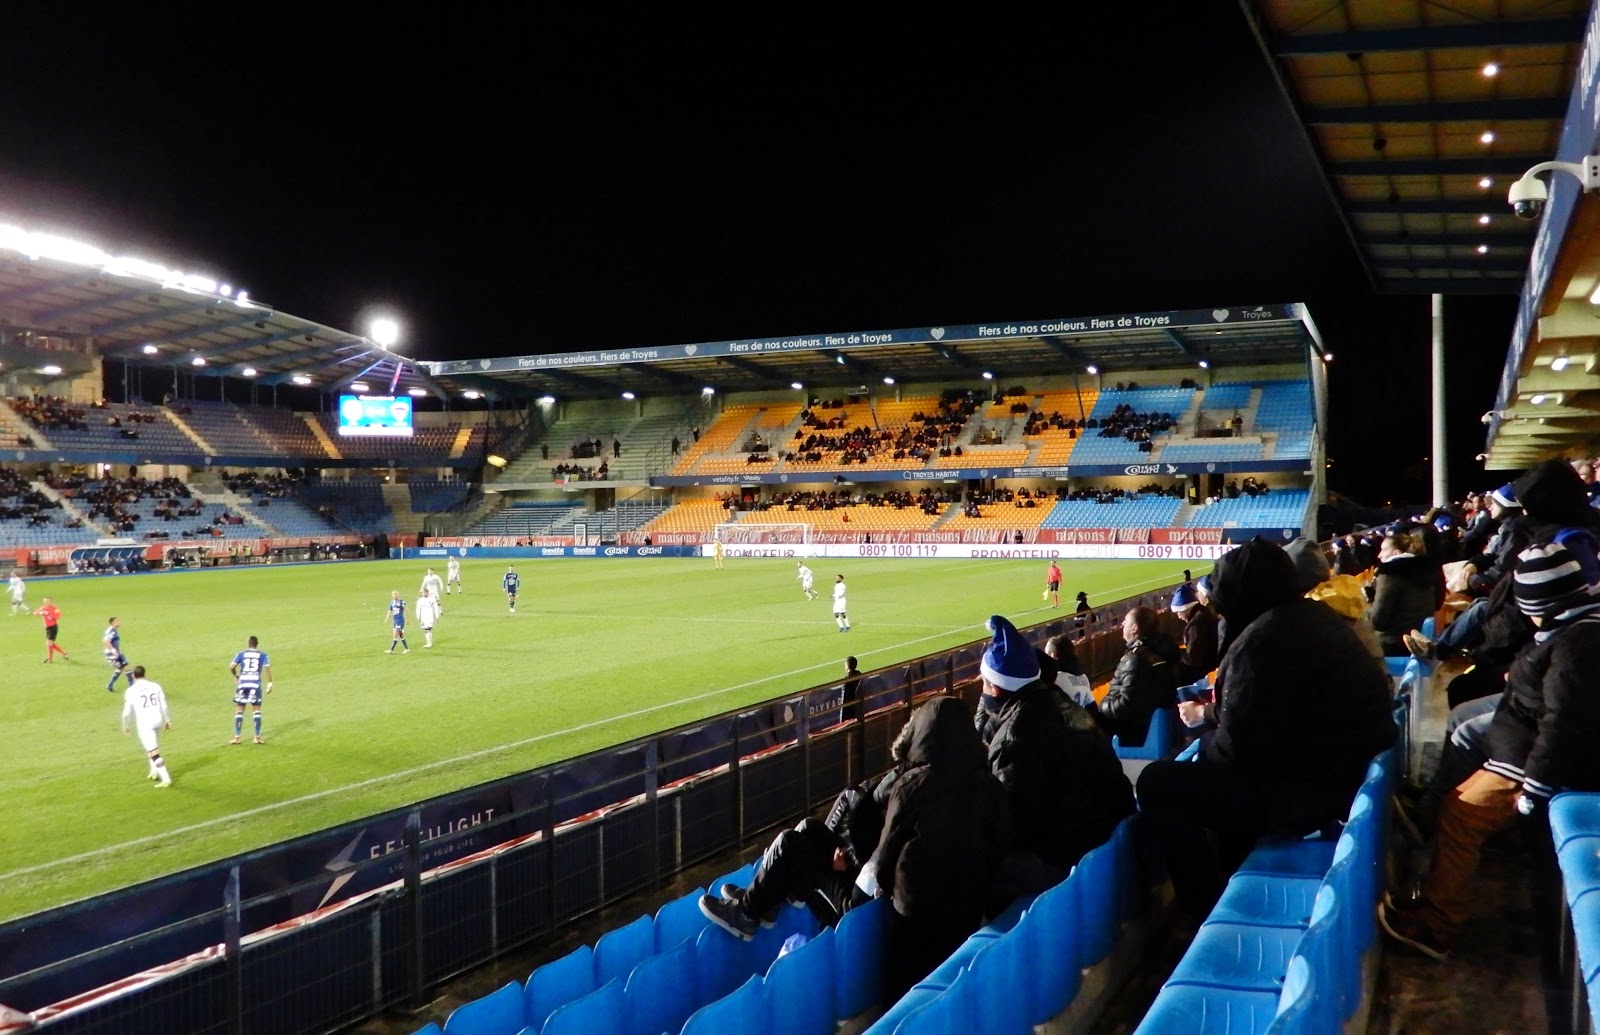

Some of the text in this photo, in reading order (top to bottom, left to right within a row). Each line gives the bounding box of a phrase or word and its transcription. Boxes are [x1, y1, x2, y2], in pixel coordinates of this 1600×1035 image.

[1241, 310, 1272, 320] Troyes
[978, 314, 1170, 336] Fiers de nos couleurs. Fiers de Troyes
[729, 333, 893, 352] Fiers de nos couleurs. Fiers de Troyes
[518, 350, 658, 367] Fiers de nos couleurs. Fiers de Troyes
[935, 470, 960, 478] HABITAT
[657, 532, 697, 543] maisons
[914, 531, 960, 543] maisons
[719, 549, 795, 557] ROMOTEUR
[859, 545, 888, 556] 0809
[891, 545, 912, 556] 100
[916, 545, 938, 556] 119
[971, 549, 1060, 558] PROMOTEUR
[1138, 545, 1173, 558] 0809
[1177, 545, 1204, 558] 100
[243, 658, 260, 672] 13
[140, 692, 158, 709] 26
[433, 844, 454, 857] YOUR
[457, 838, 474, 850] LIFE
